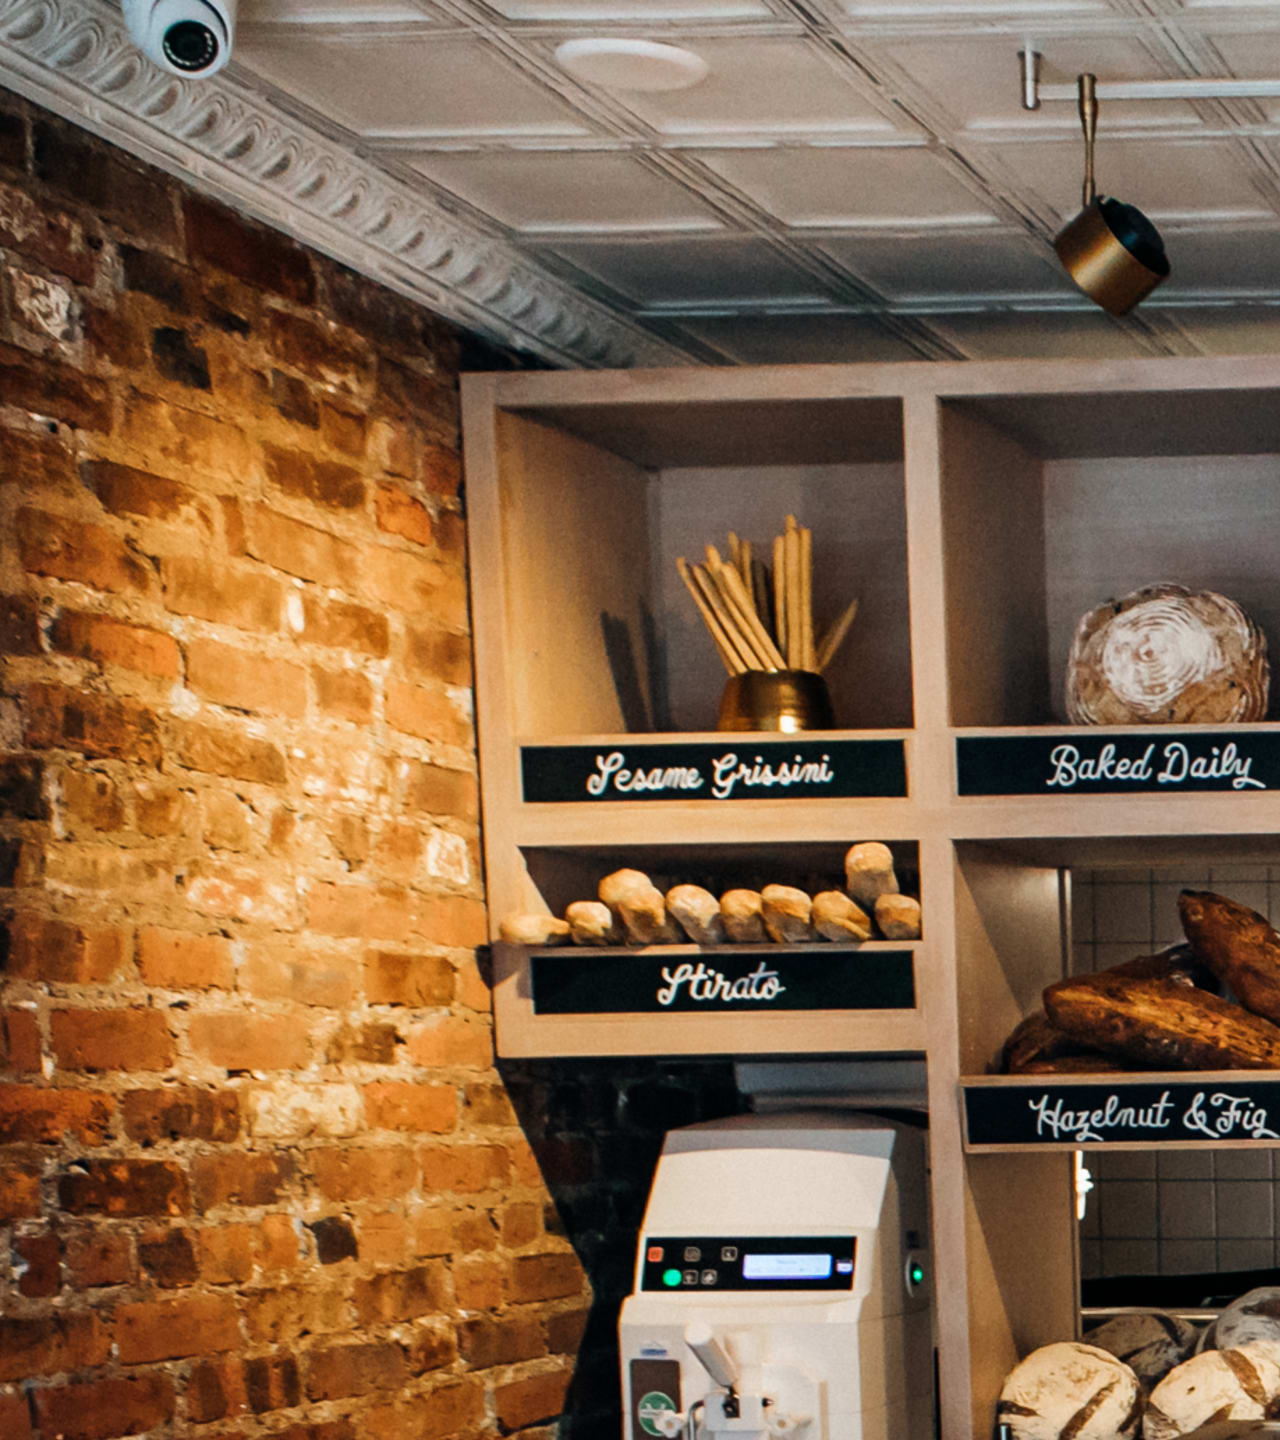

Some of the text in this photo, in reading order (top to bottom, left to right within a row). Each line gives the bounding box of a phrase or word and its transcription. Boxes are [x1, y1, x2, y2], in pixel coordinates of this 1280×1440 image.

[586, 751, 834, 799] Sesame Grissini
[1046, 741, 1266, 789] Baked Daily
[657, 962, 786, 1006] Stirato
[1028, 1091, 1280, 1142] Hazelnut & Fig
